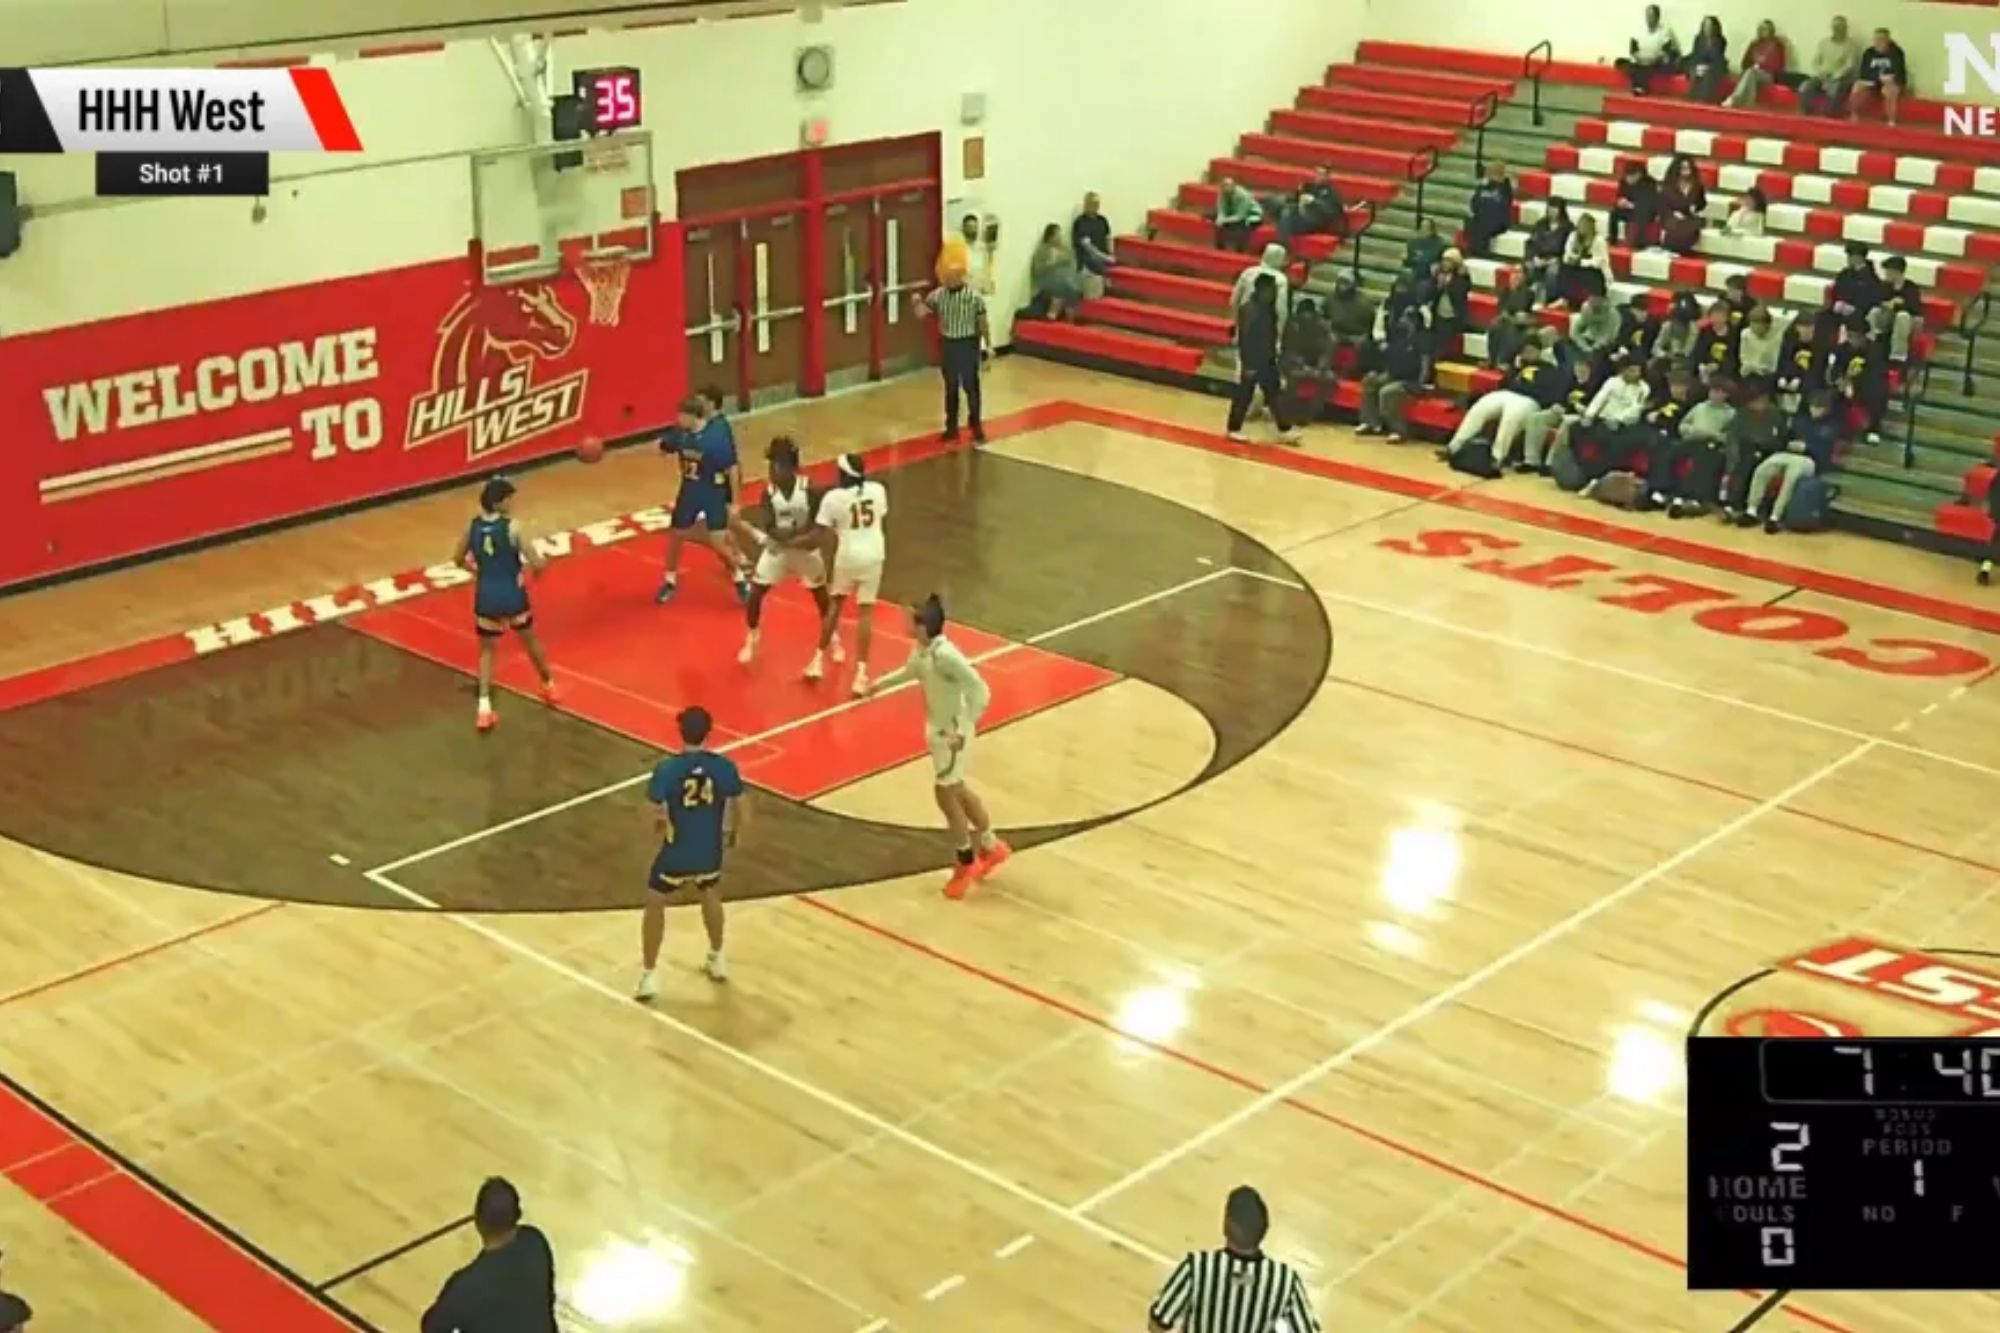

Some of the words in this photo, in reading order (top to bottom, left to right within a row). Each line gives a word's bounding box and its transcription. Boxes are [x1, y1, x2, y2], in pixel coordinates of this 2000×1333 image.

[594, 78, 635, 122] 35
[42, 326, 379, 442] WELCOME
[412, 365, 527, 439] HILLS
[473, 380, 580, 451] WEST
[300, 397, 383, 461] TO
[848, 498, 875, 531] 15
[185, 560, 473, 654] HILLS
[1374, 529, 1990, 676] COLTS
[683, 776, 714, 809] 24
